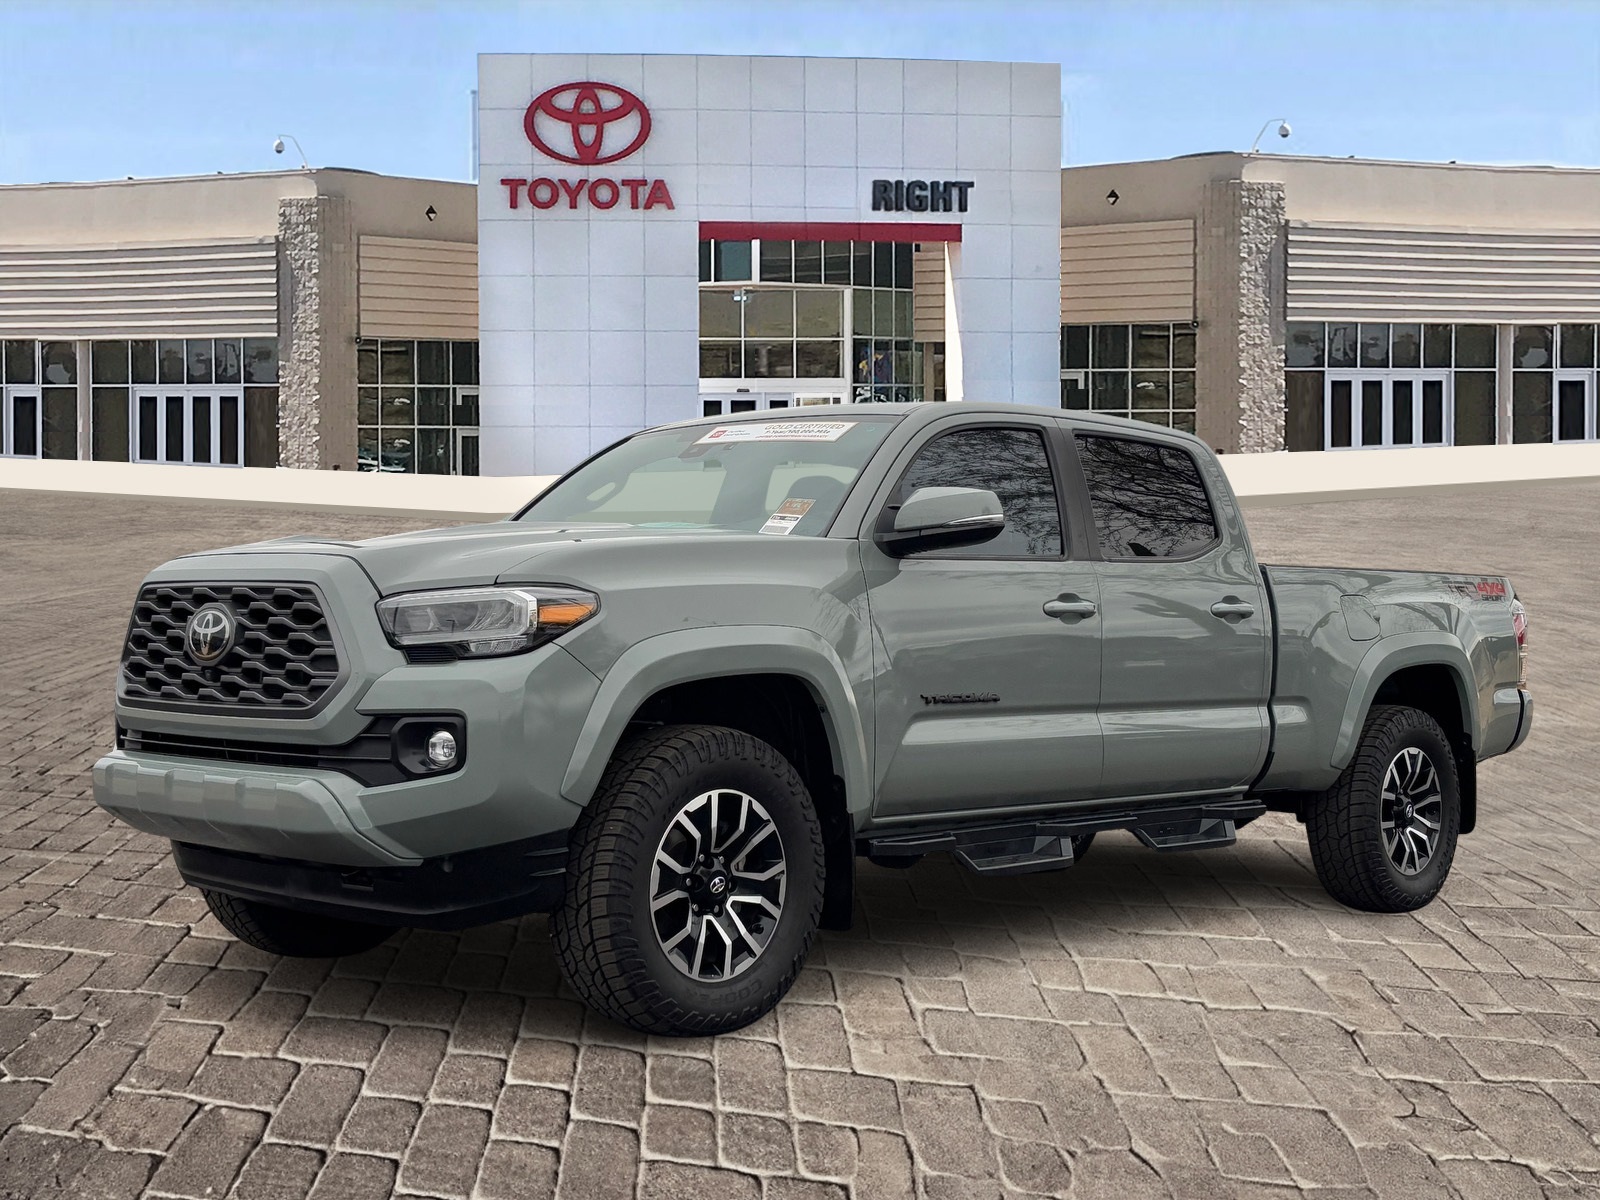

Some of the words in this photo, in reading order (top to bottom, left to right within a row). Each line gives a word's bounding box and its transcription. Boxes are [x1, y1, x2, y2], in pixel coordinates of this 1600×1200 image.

[500, 177, 675, 210] TOYOTA
[872, 180, 975, 212] RIGHT
[920, 692, 1000, 705] TACOMA
